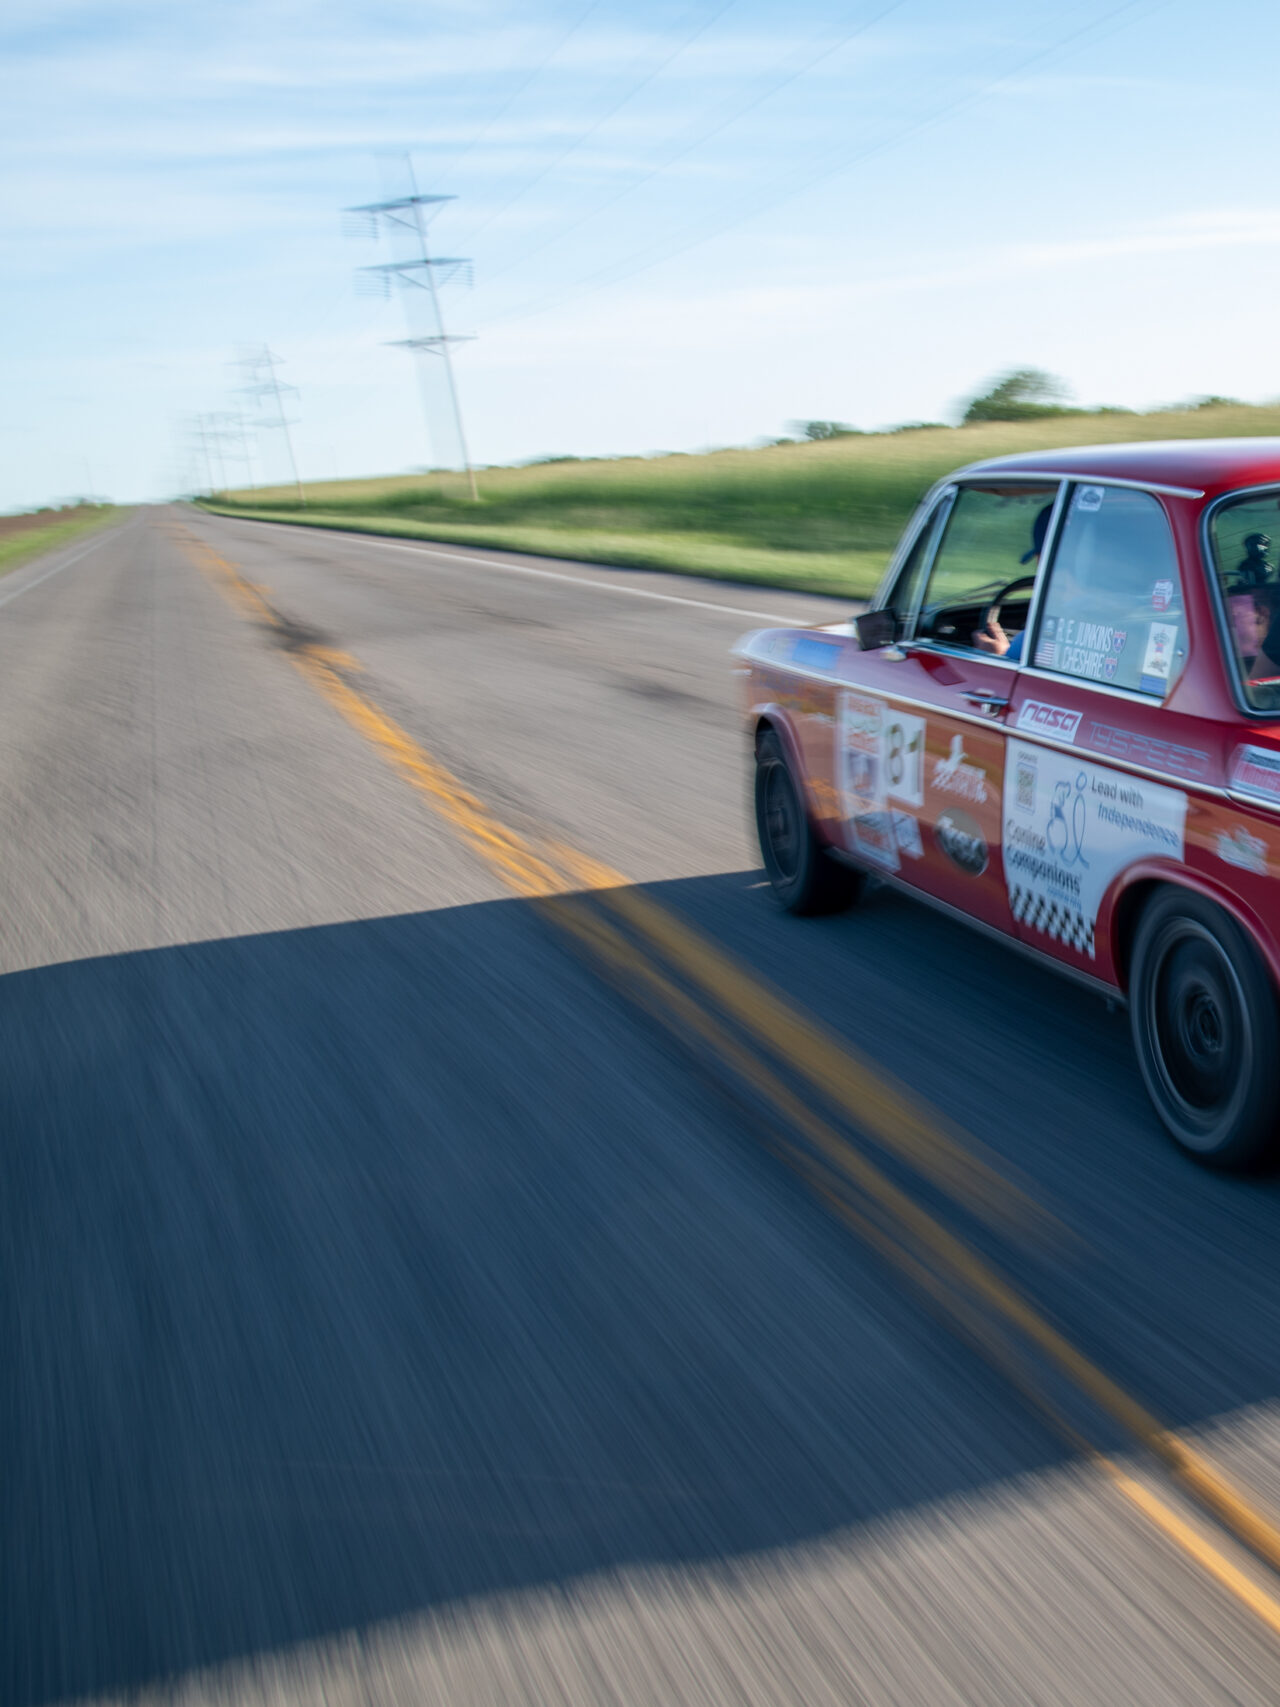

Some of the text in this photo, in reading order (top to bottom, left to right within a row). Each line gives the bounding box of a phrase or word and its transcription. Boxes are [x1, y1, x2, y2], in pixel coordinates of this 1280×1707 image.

[883, 723, 922, 796] 81
[1091, 775, 1144, 811] Lead with
[1098, 802, 1180, 849] Independence
[1004, 844, 1081, 898] Companions
